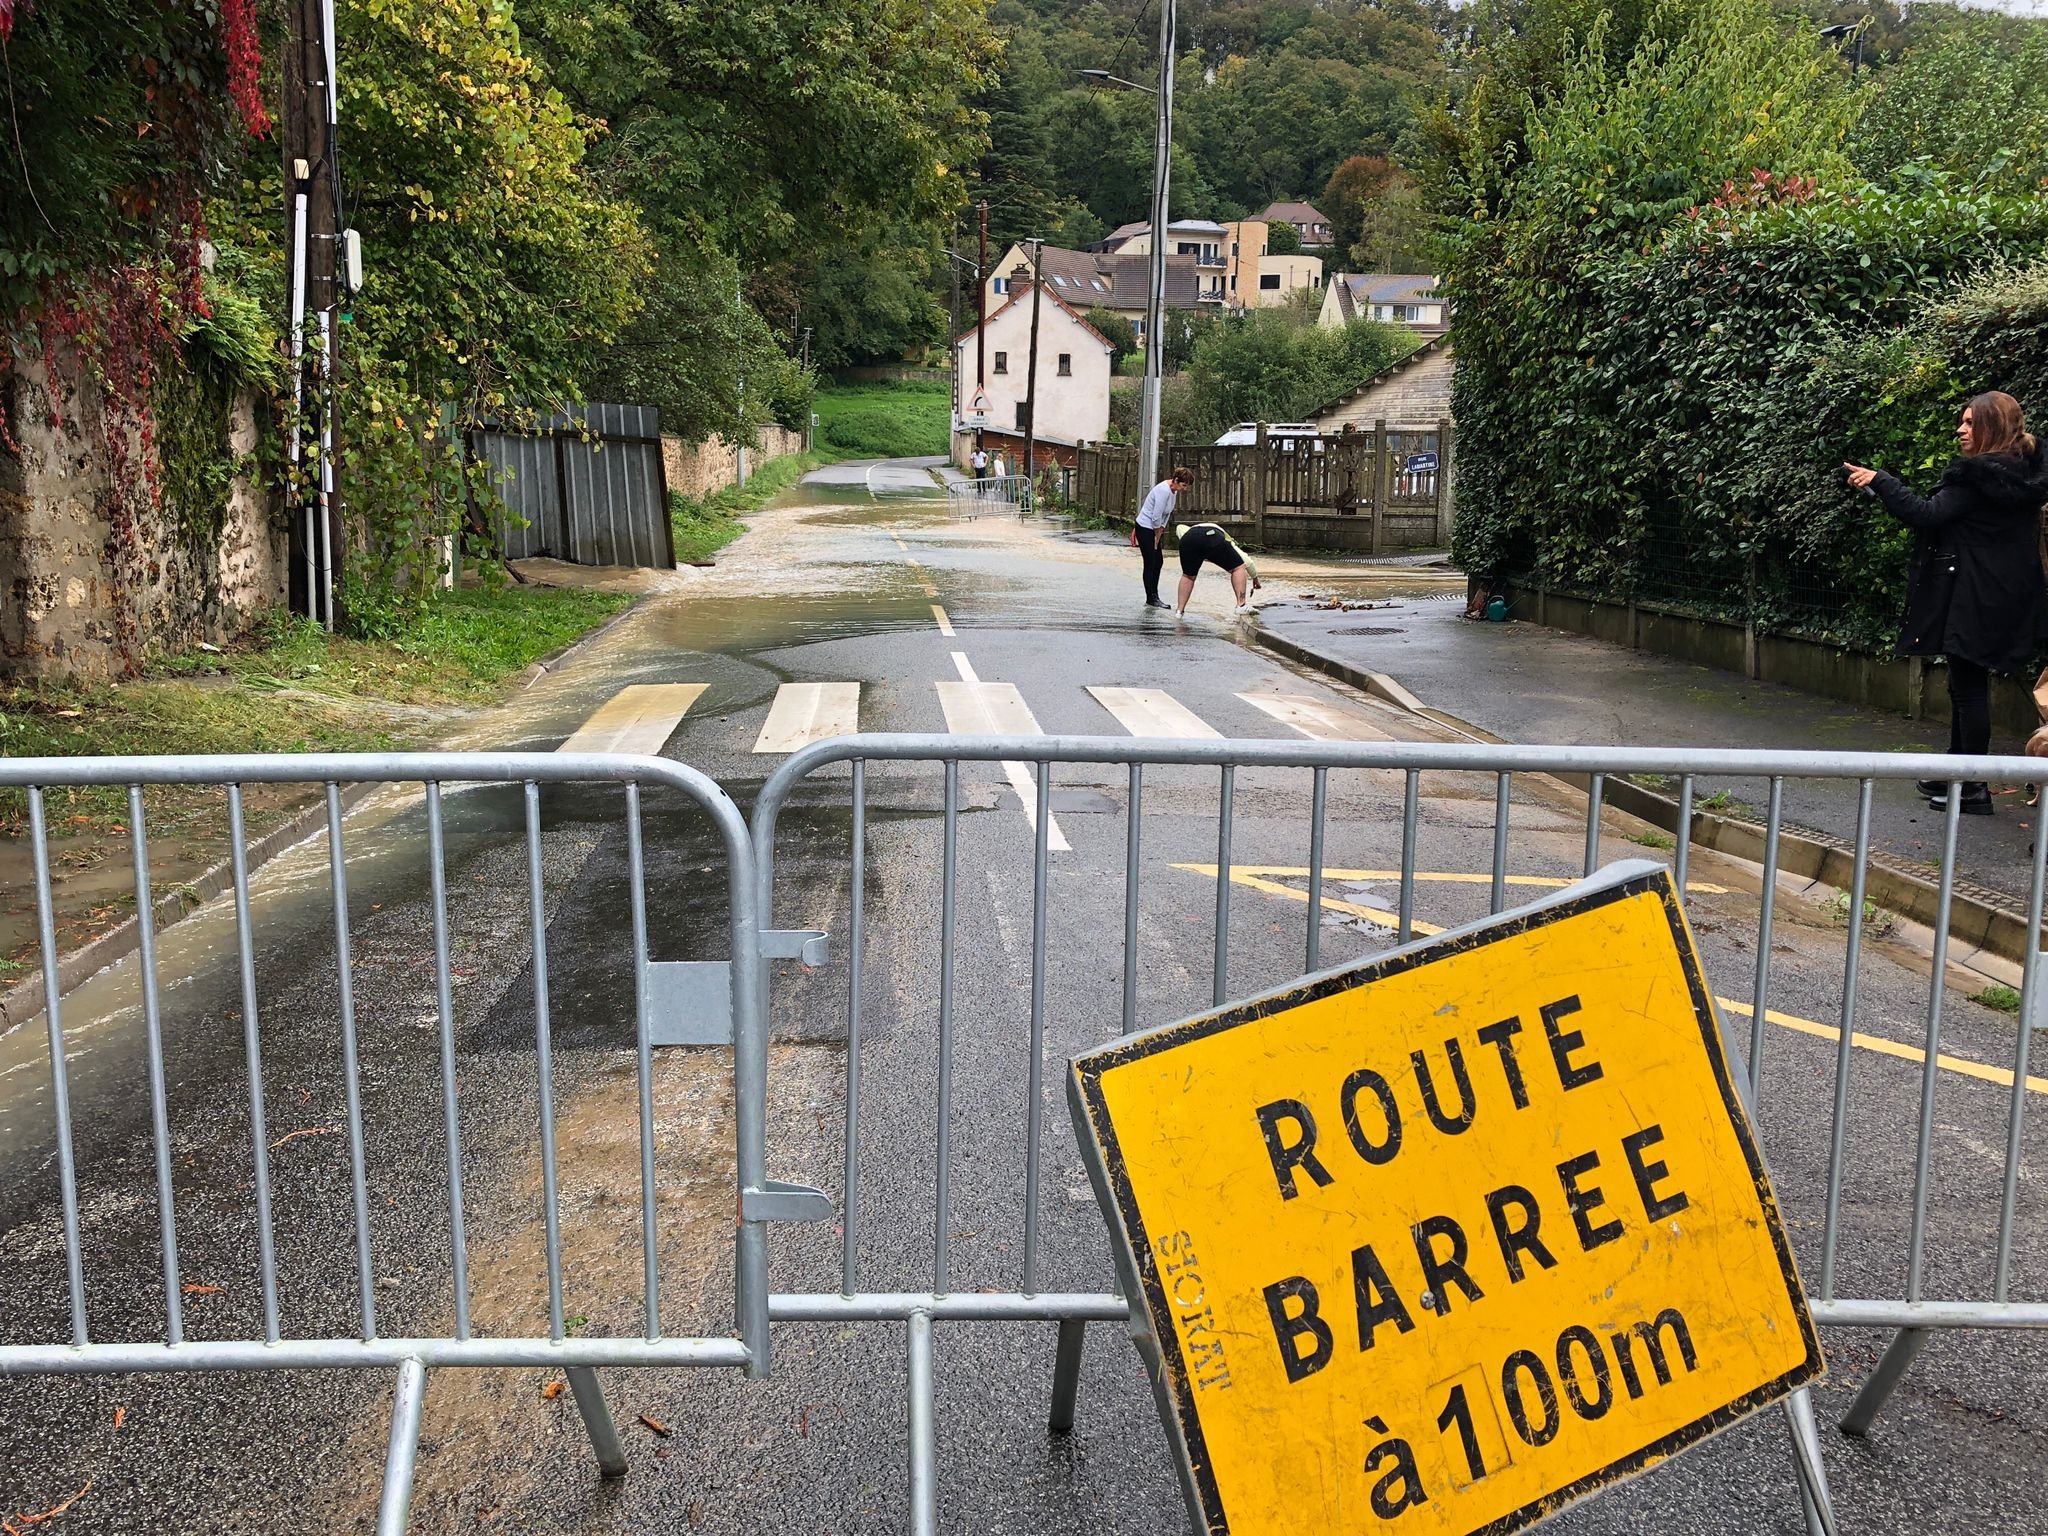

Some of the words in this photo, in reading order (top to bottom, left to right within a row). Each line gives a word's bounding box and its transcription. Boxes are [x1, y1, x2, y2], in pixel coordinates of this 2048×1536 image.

[1411, 461, 1436, 470] LAMARTINE
[1255, 994, 1604, 1201] ROUTE
[1158, 1230, 1233, 1392] SIORAT
[1262, 1124, 1690, 1385] BARREE
